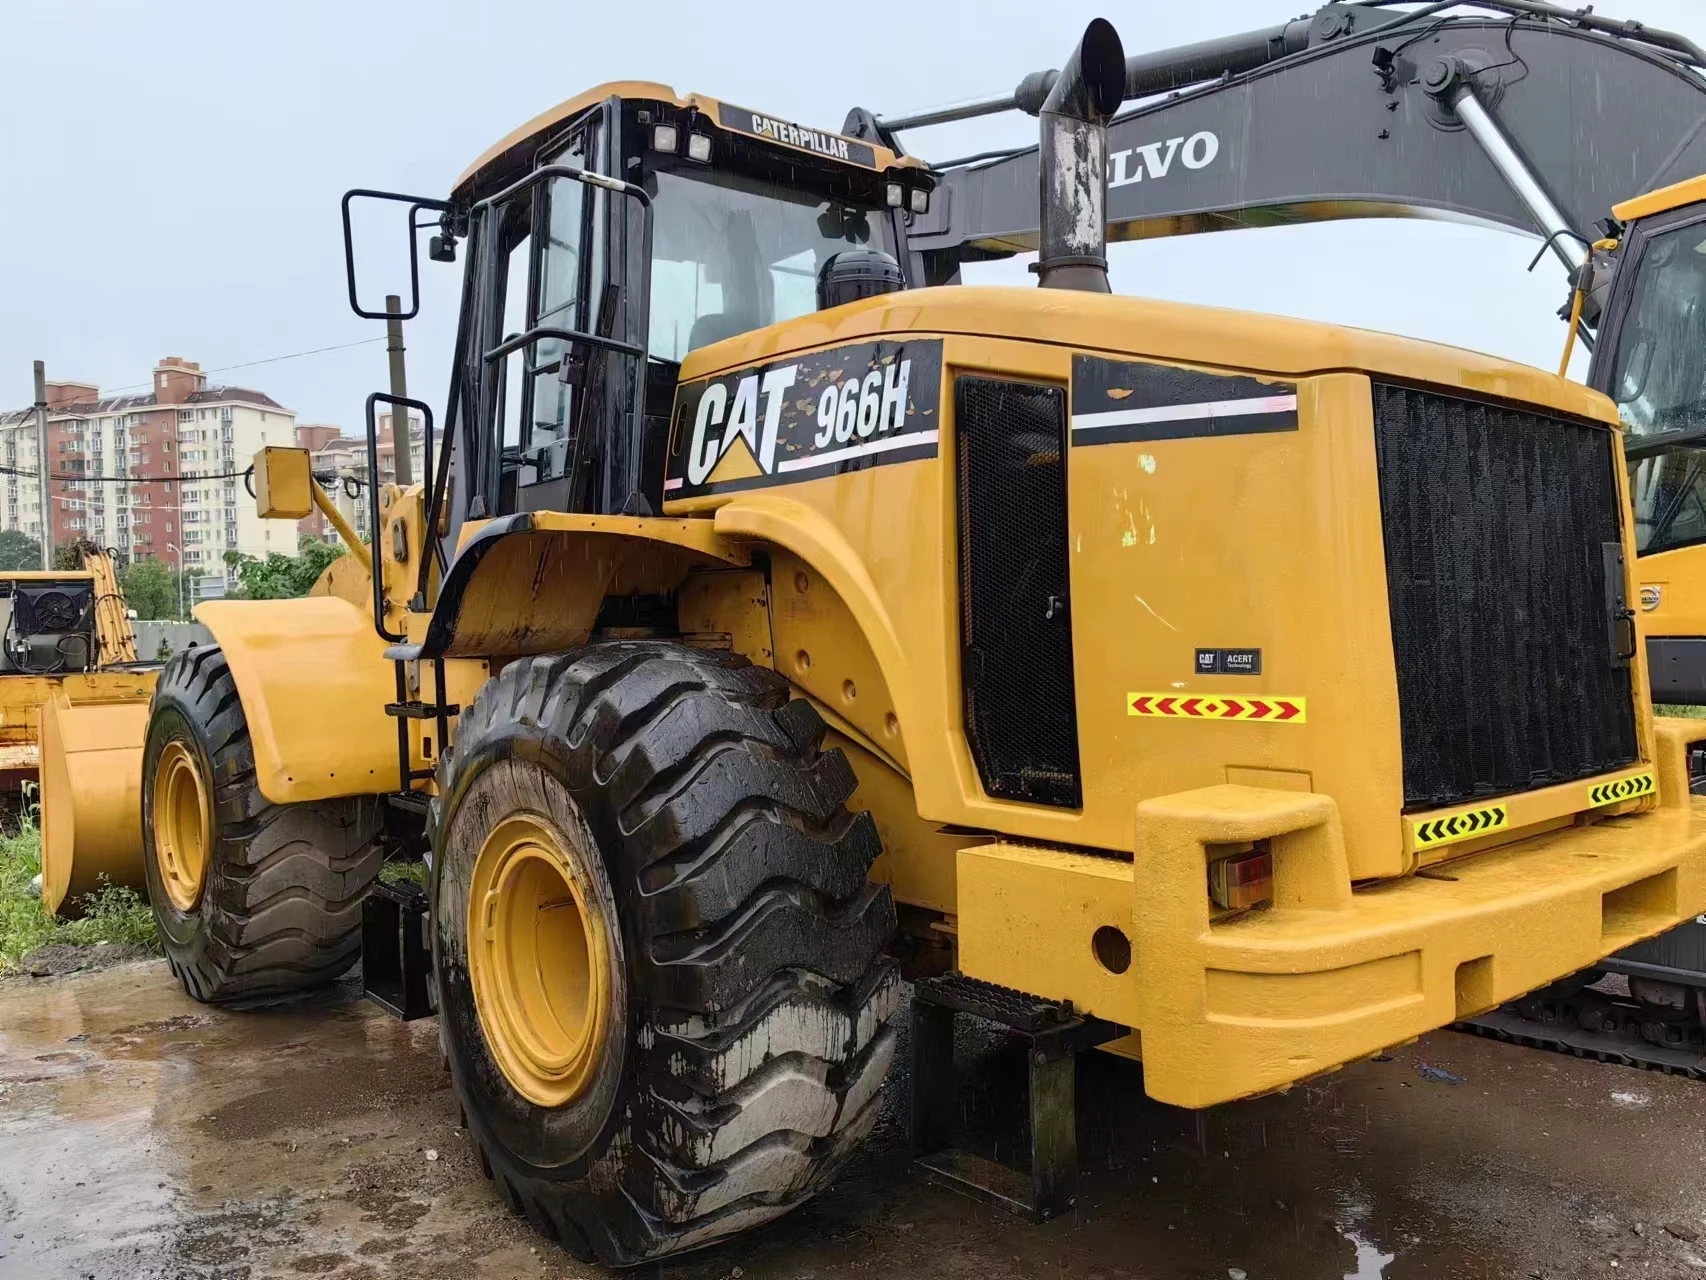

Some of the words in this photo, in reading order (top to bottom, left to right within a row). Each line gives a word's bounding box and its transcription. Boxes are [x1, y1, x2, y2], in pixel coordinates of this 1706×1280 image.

[751, 114, 849, 160] CATERPILLAR
[1106, 131, 1219, 188] LVO
[687, 364, 798, 486] CAT
[814, 359, 911, 449] 966H
[1199, 653, 1215, 664] CAT
[1227, 654, 1253, 663] ACERT
